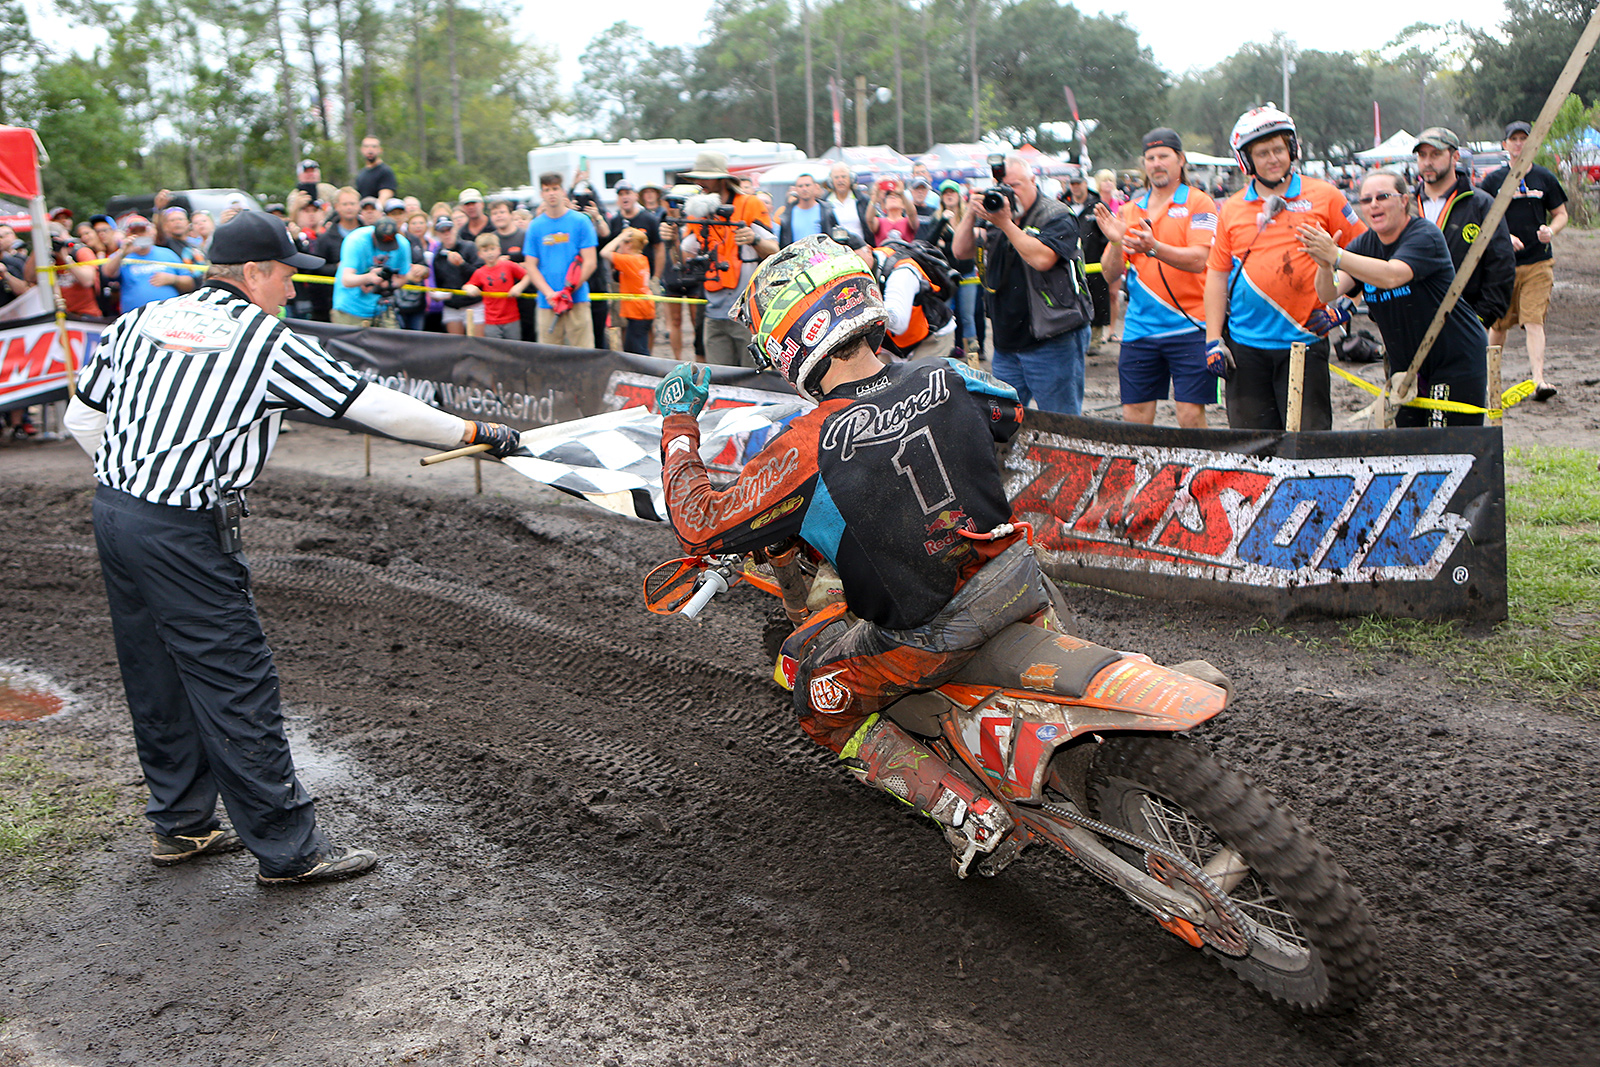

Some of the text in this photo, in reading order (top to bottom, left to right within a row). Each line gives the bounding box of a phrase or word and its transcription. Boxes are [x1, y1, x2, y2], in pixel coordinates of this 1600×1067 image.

[163, 330, 206, 343] RACING
[805, 315, 826, 342] BELL
[822, 368, 950, 462] Russell
[890, 425, 956, 516] 1
[924, 531, 955, 556] Red
[954, 517, 977, 542] Bll
[1006, 443, 1456, 572] AMSOIL
